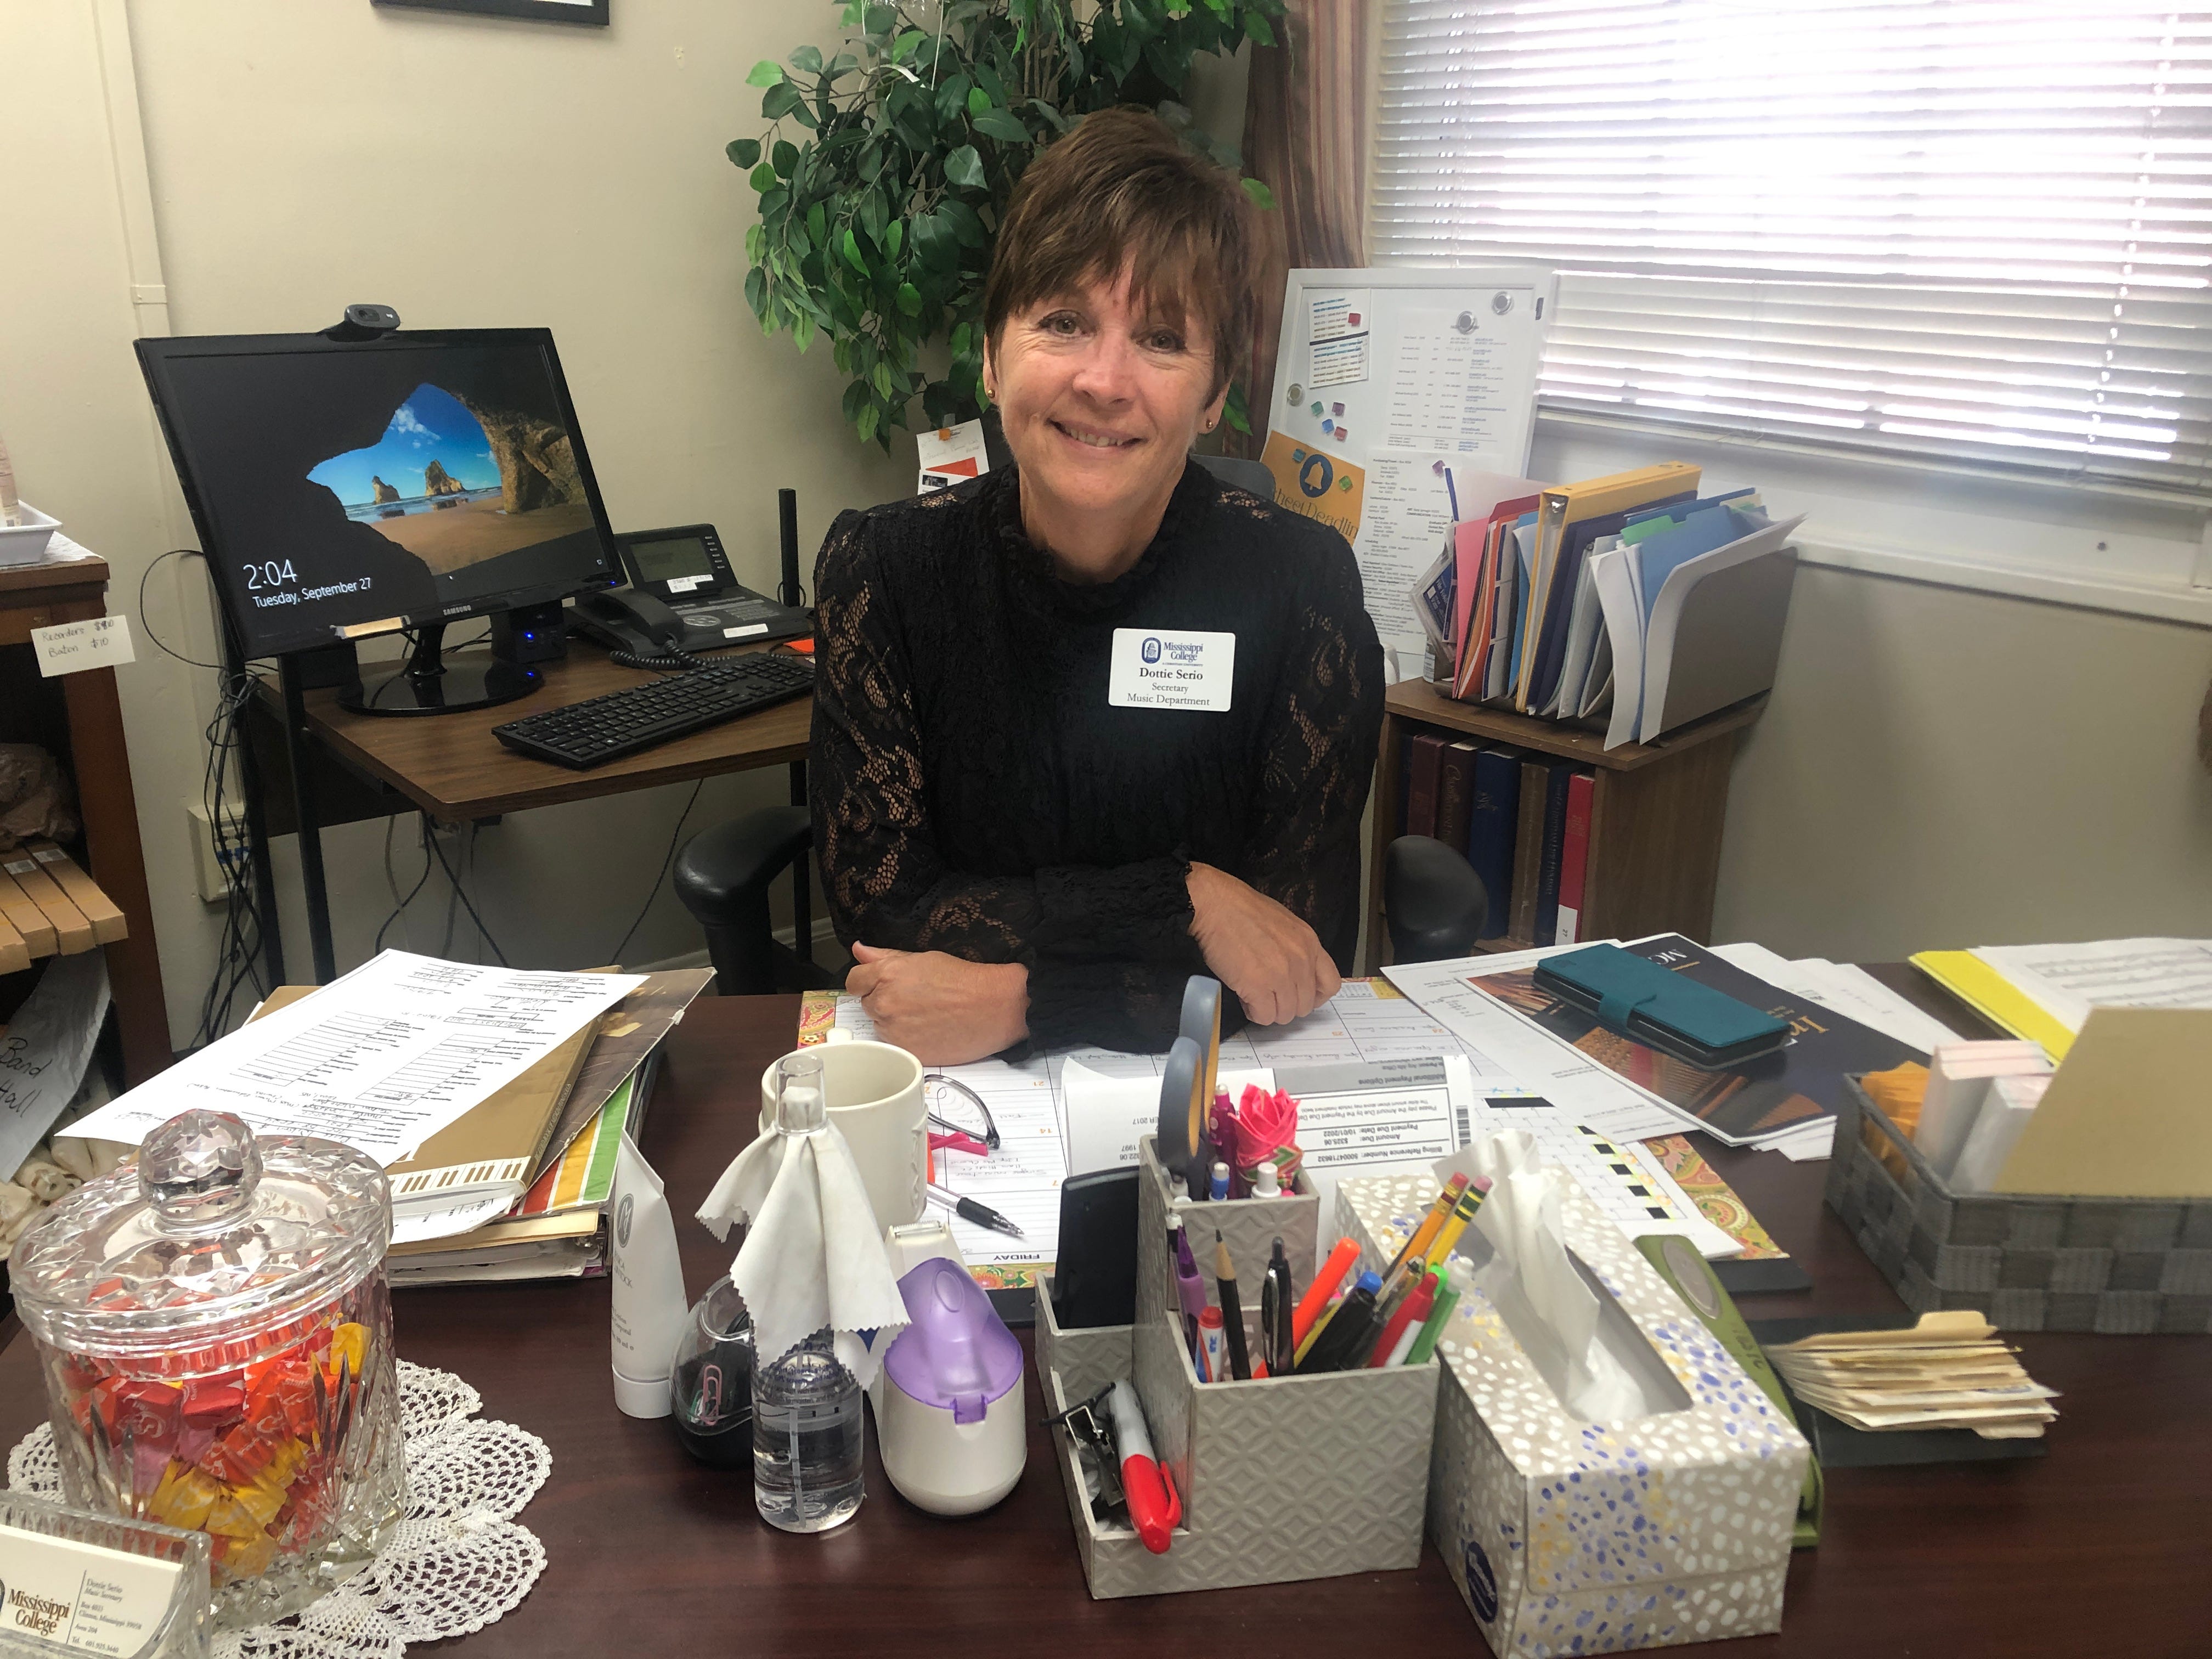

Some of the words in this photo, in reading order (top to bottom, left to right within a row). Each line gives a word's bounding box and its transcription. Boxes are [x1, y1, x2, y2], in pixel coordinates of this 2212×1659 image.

[1306, 502, 1358, 539] Deadlin
[243, 559, 297, 589] 2:04
[252, 592, 301, 608] Tuesday,
[301, 581, 357, 601] September
[360, 577, 373, 590] 27
[443, 605, 471, 616] SAMSUNG
[42, 628, 84, 642] Recorders
[48, 645, 78, 658] Baton
[91, 637, 109, 648] $10
[1164, 642, 1204, 654] Mississippi
[1171, 651, 1198, 663] College
[1139, 667, 1173, 679] Dottie
[1176, 669, 1203, 680] Serio
[1152, 682, 1189, 695] Secretary
[1127, 693, 1154, 703] Music
[1156, 695, 1210, 707] Department
[1562, 928, 1568, 937] 27
[0, 1037, 53, 1080] Band
[0, 1079, 42, 1118] Hall
[1324, 1128, 1356, 1137] 10/01/2022
[1391, 1124, 1418, 1133] Payment
[87, 1578, 106, 1590] Dottie
[108, 1583, 123, 1593] Serio
[101, 1591, 123, 1602] Secretary
[8, 1589, 70, 1621] Mississippi
[15, 1610, 57, 1636] College
[100, 1614, 125, 1627] Mississippi
